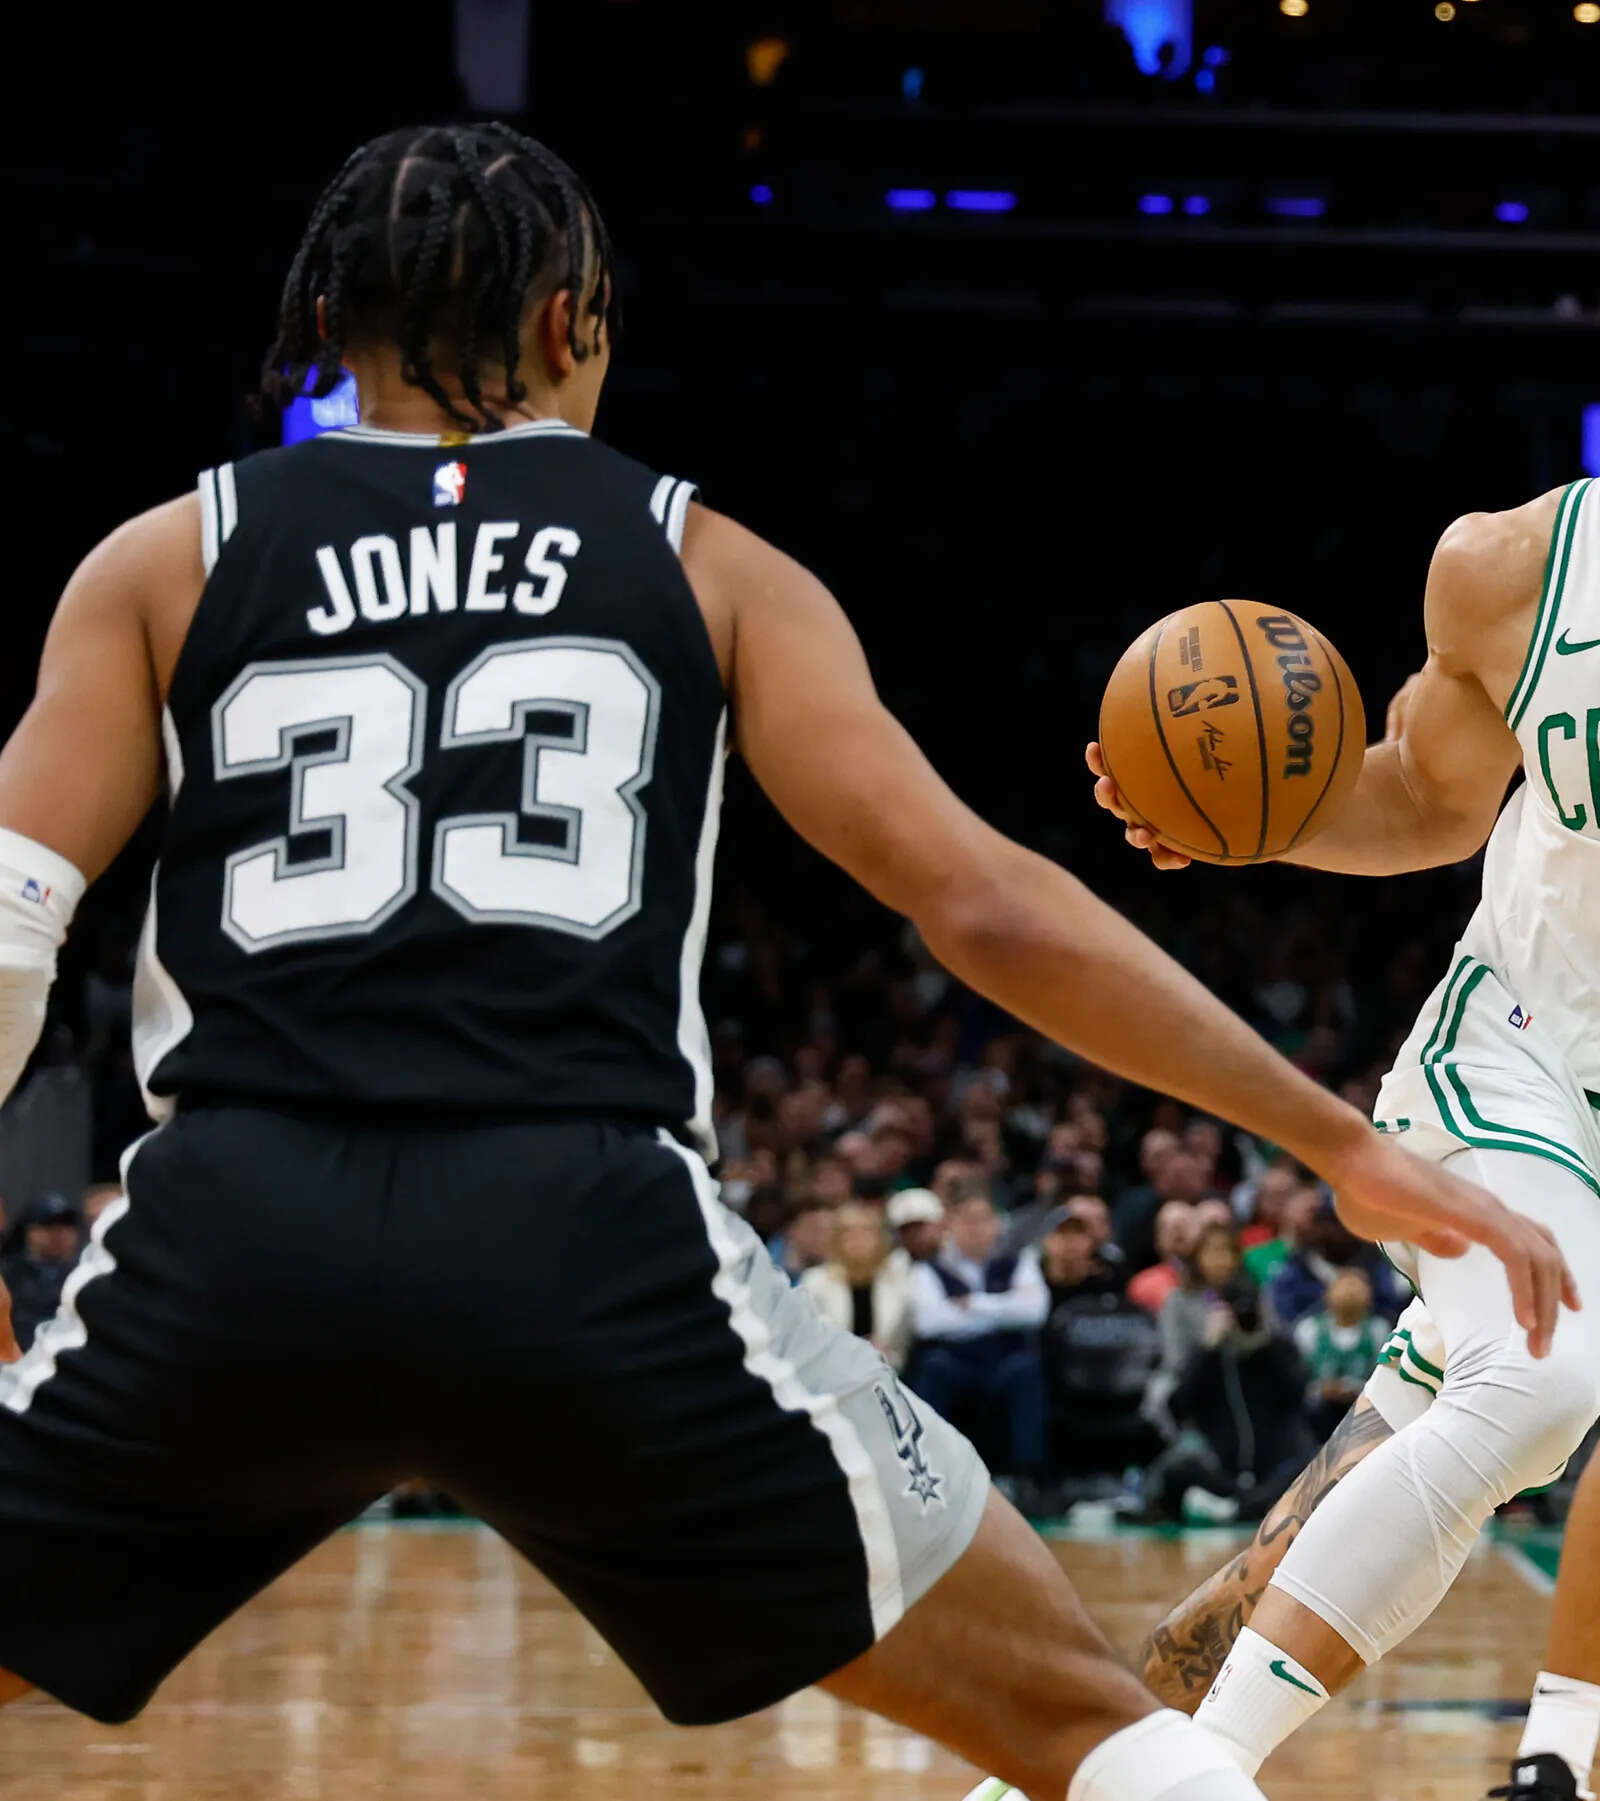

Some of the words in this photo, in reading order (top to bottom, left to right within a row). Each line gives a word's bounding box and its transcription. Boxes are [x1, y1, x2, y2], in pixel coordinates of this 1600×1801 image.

[306, 521, 581, 636] JONES
[1255, 614, 1323, 780] Wilson
[211, 636, 661, 955] 33
